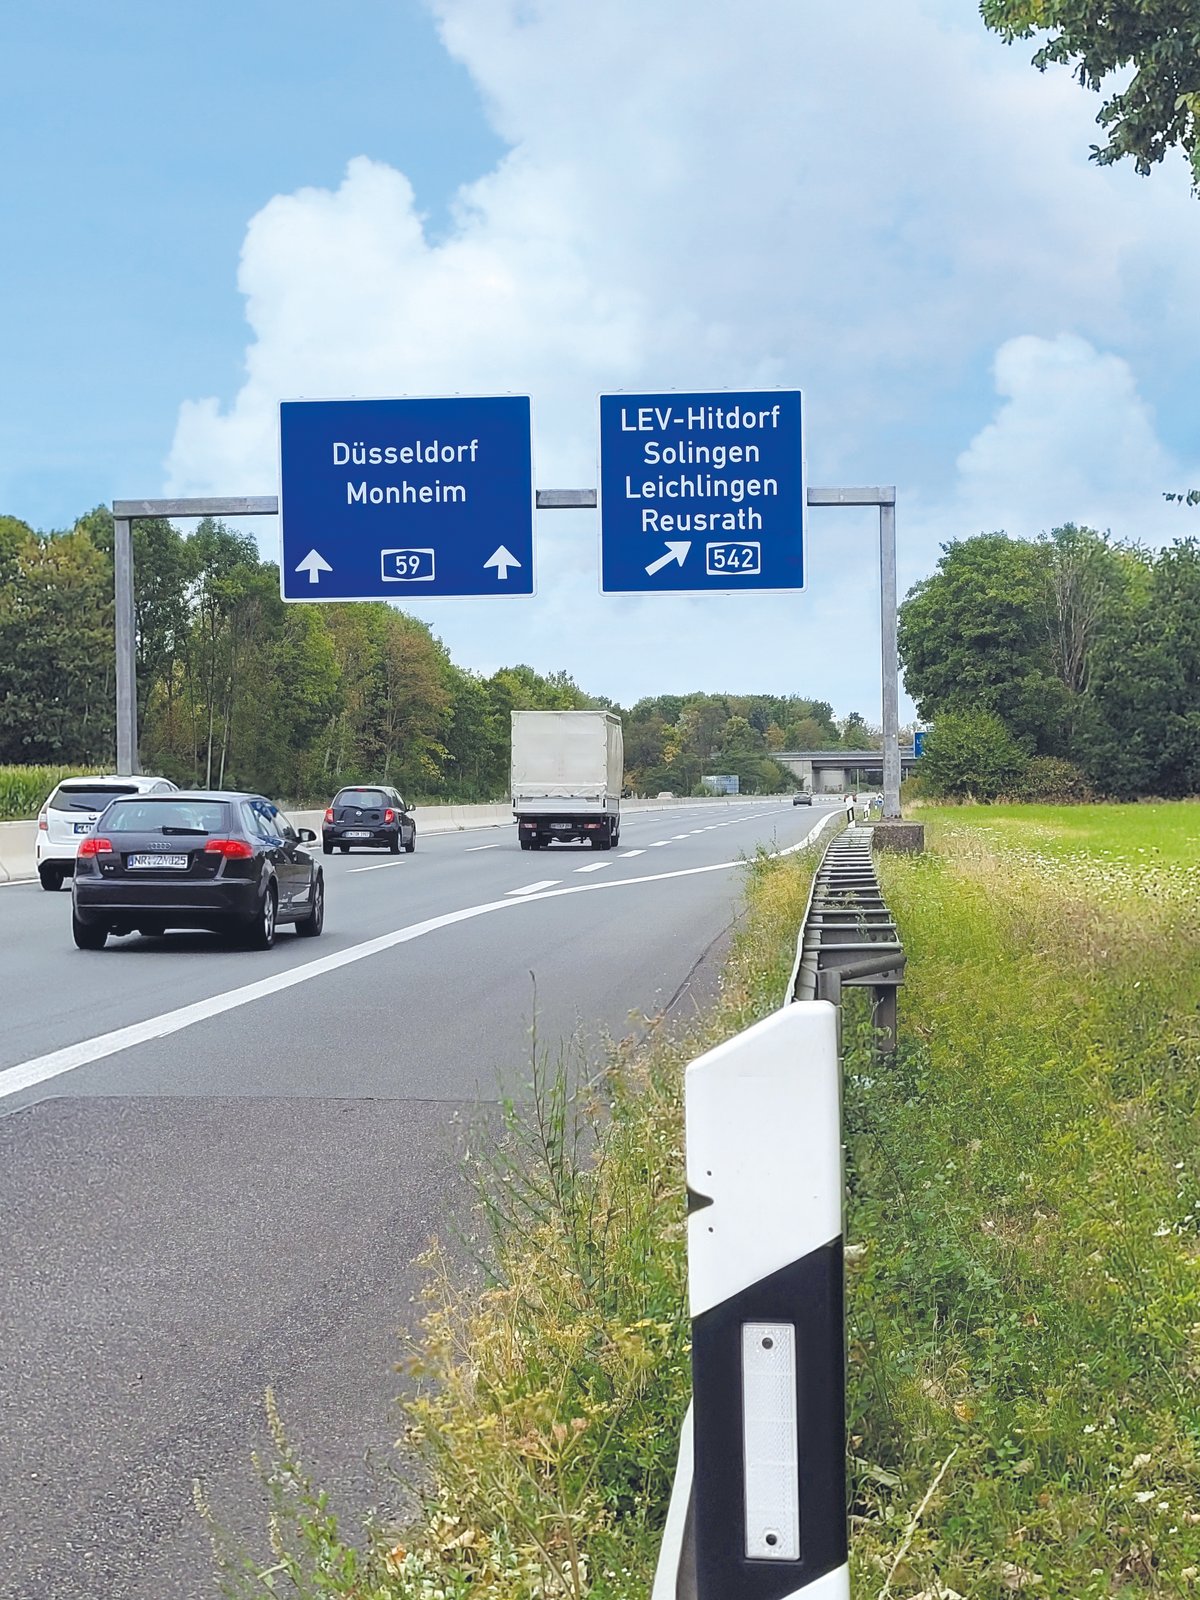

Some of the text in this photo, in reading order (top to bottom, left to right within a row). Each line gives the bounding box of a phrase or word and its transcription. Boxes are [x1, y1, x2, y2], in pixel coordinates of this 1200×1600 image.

[621, 405, 780, 431] LEV-Hitdorf
[333, 439, 479, 465] Düsseldorf
[643, 440, 760, 469] Solingen
[347, 479, 466, 505] Monheim
[625, 474, 778, 503] Leichlingen
[642, 506, 762, 532] Reusrath
[396, 555, 420, 575] 59
[714, 548, 753, 568] 542
